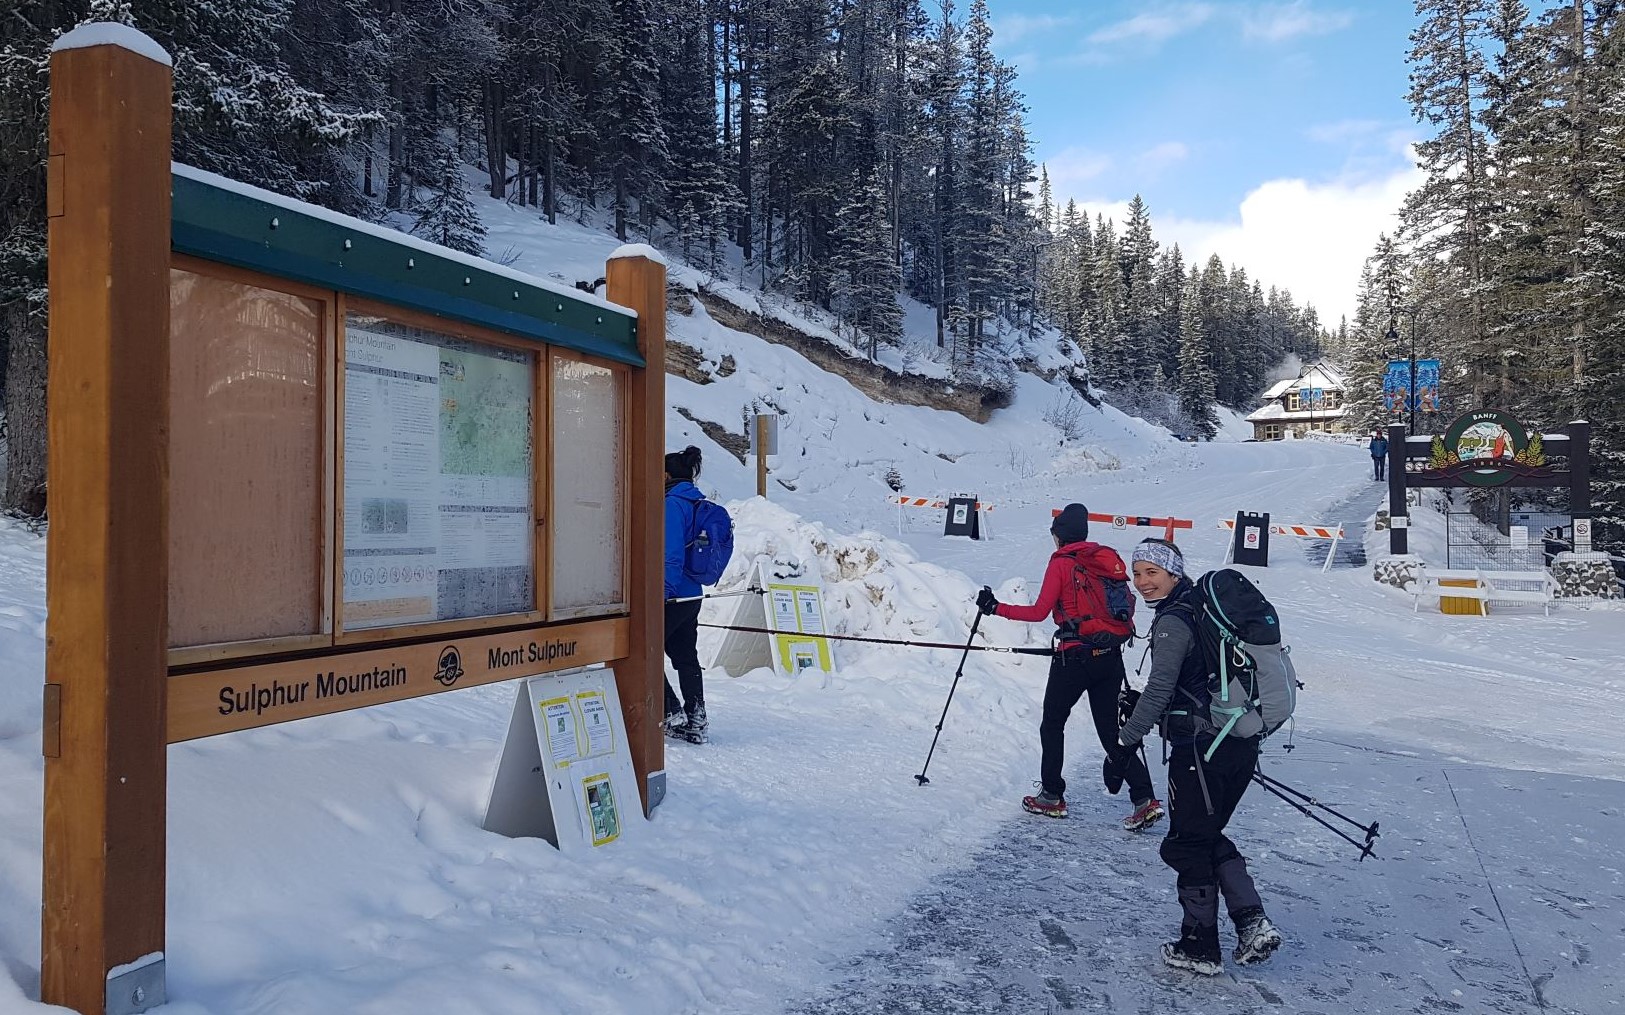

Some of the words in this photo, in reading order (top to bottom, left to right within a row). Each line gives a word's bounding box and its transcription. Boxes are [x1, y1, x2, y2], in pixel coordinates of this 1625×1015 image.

[488, 645, 524, 669] Mont
[527, 638, 578, 664] Sulphur
[218, 680, 310, 716] Sulphur
[316, 663, 407, 699] Mountain
